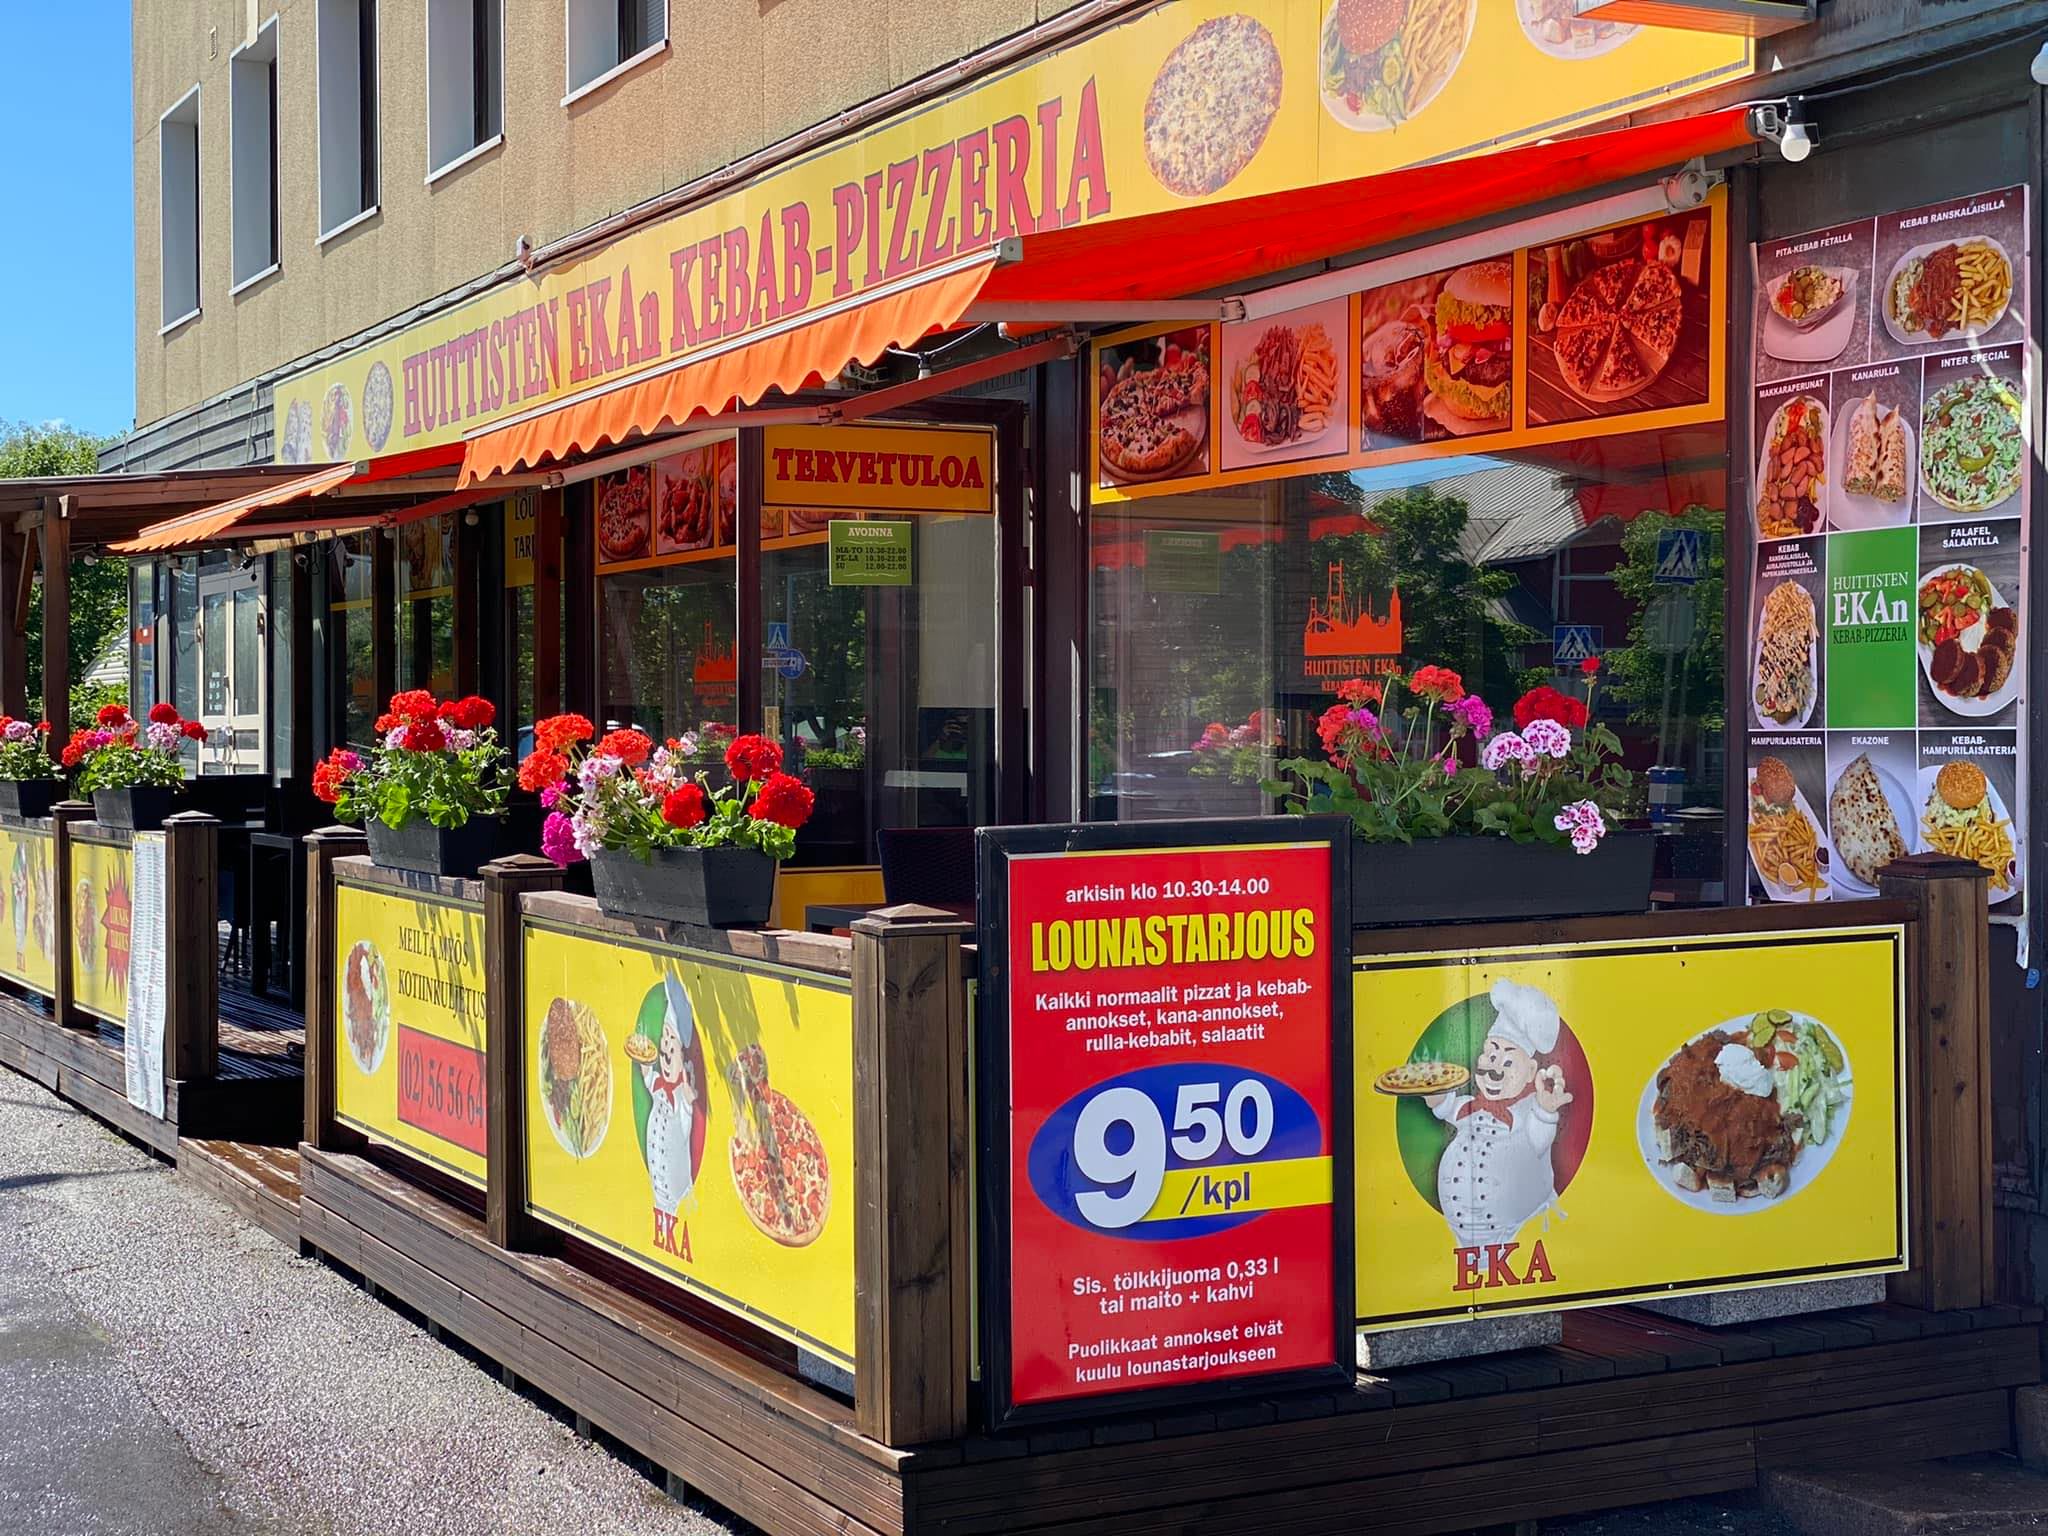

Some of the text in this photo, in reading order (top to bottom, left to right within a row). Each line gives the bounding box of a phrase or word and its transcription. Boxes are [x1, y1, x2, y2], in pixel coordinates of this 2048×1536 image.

[1900, 199, 2006, 229] KEBAB RANSKALAISILLA
[403, 73, 1112, 438] HUITTISTEN EKAn KEBAB-PIZZERIA
[1775, 232, 1853, 258] PITA-KEBAB FETALLA
[1851, 366, 1900, 382] KANARULLA
[1941, 350, 2010, 369] INTER SPECIAL
[1759, 378, 1825, 398] MAKKARAPERUNAT
[772, 447, 985, 489] TERVETULOA
[847, 527, 894, 537] AVOINNA
[1942, 535, 1999, 549] SALAATILLA
[1950, 525, 1991, 539] FALAFEL
[1778, 543, 1800, 554] KEBAB
[1833, 571, 1909, 591] HUITTISTEN
[1832, 589, 1910, 627] EKAn
[1832, 626, 1908, 645] KEBAB-PIZZERIA
[1304, 659, 1370, 676] HUITTISTEN
[1751, 736, 1823, 745] HAMPURILAISATERIA
[1851, 736, 1889, 745] EKAZONE
[1922, 745, 2017, 756] HAMPURILAISATERIA
[1951, 735, 1986, 745] KEBAB-
[1065, 878, 1270, 904] arkisin klo 10.30-14.00
[399, 926, 469, 967] MEILTÄ MYÖS
[1031, 907, 1315, 973] LOUNASTARJOUS
[398, 968, 486, 1020] KOTIINKULJETUS
[1035, 978, 1313, 1012] Kaikki normaalit pizzat ja kebab-
[1065, 1001, 1285, 1032] annokset, kana-annokset,
[1085, 1023, 1266, 1053] rulla-kebabit, salaatit
[401, 1037, 424, 1113] (02)
[428, 1058, 443, 1113] 56
[447, 1065, 463, 1121] 56
[1179, 1170, 1251, 1216] /kpl
[652, 1206, 694, 1265] EKA
[1072, 1256, 1279, 1297] Sis. tölkkijuoma 0,33 l
[1451, 1239, 1556, 1292] EKA
[1099, 1295, 1124, 1315] tai
[1130, 1291, 1183, 1312] maito
[1206, 1280, 1254, 1304] kahvi
[1068, 1319, 1284, 1360] Puolikkaat annokset eivät
[1075, 1346, 1277, 1384] kuulu lounastarjoukseen
